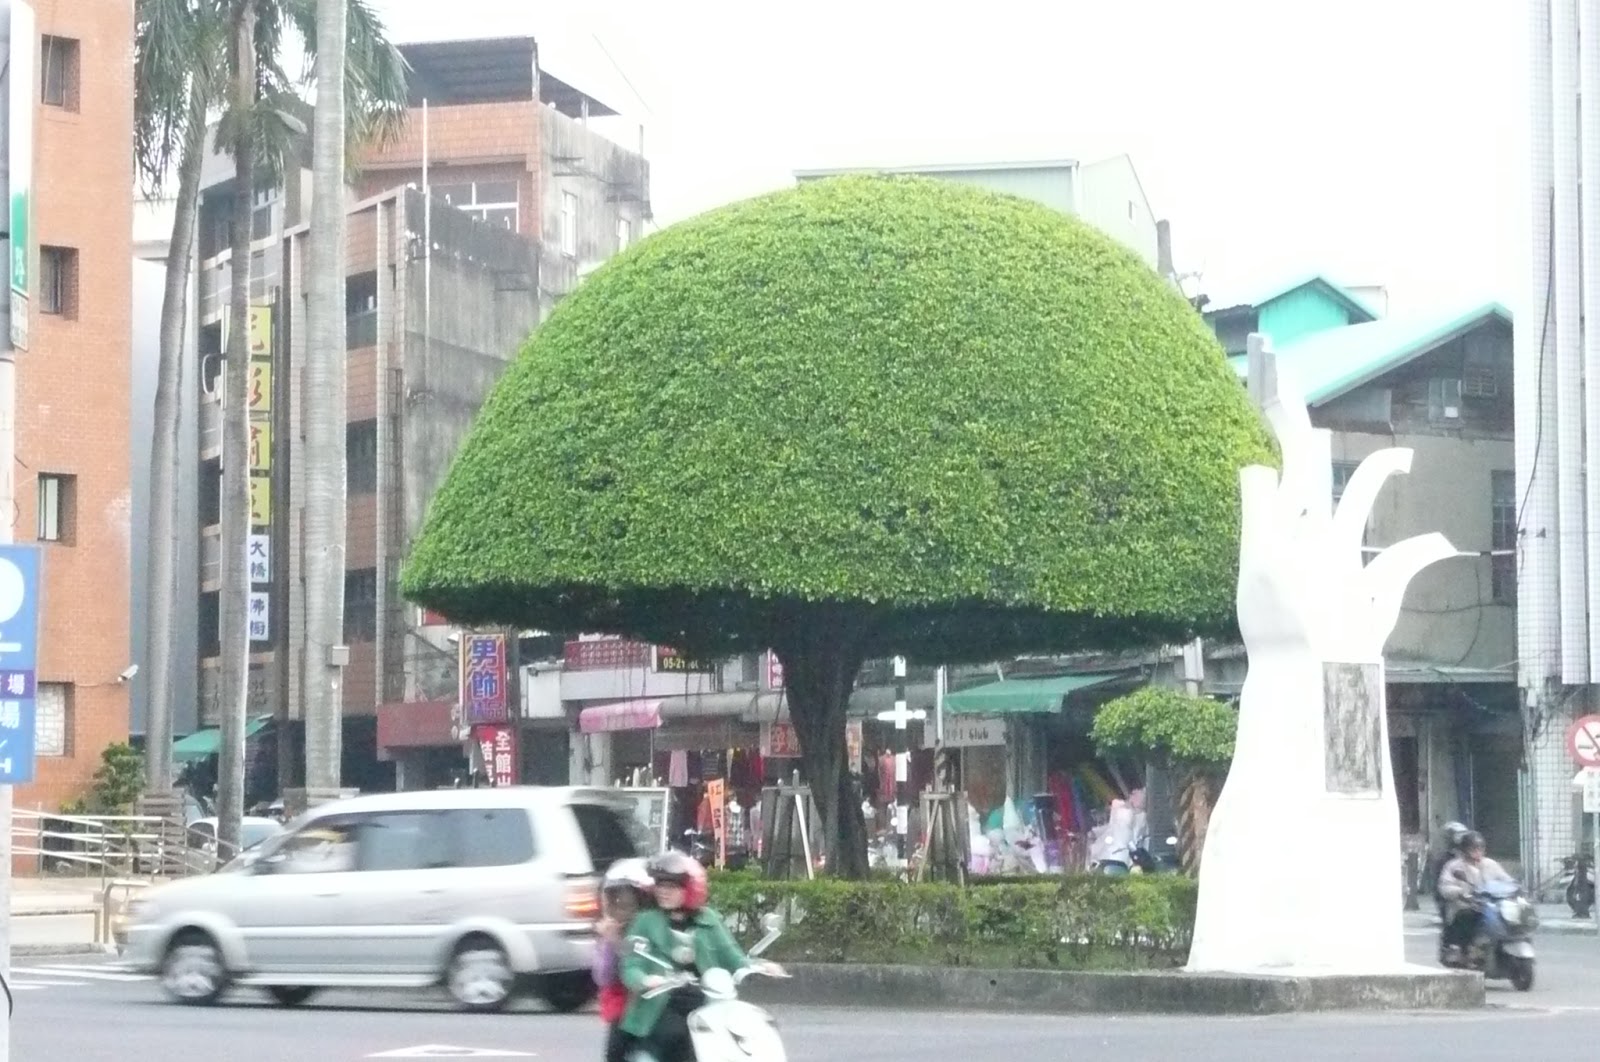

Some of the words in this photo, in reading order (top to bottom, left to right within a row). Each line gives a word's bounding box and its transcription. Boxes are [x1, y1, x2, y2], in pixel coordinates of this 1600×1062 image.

[250, 540, 266, 578] 大橋
[0, 673, 25, 695] 場
[471, 638, 499, 700] 男飾
